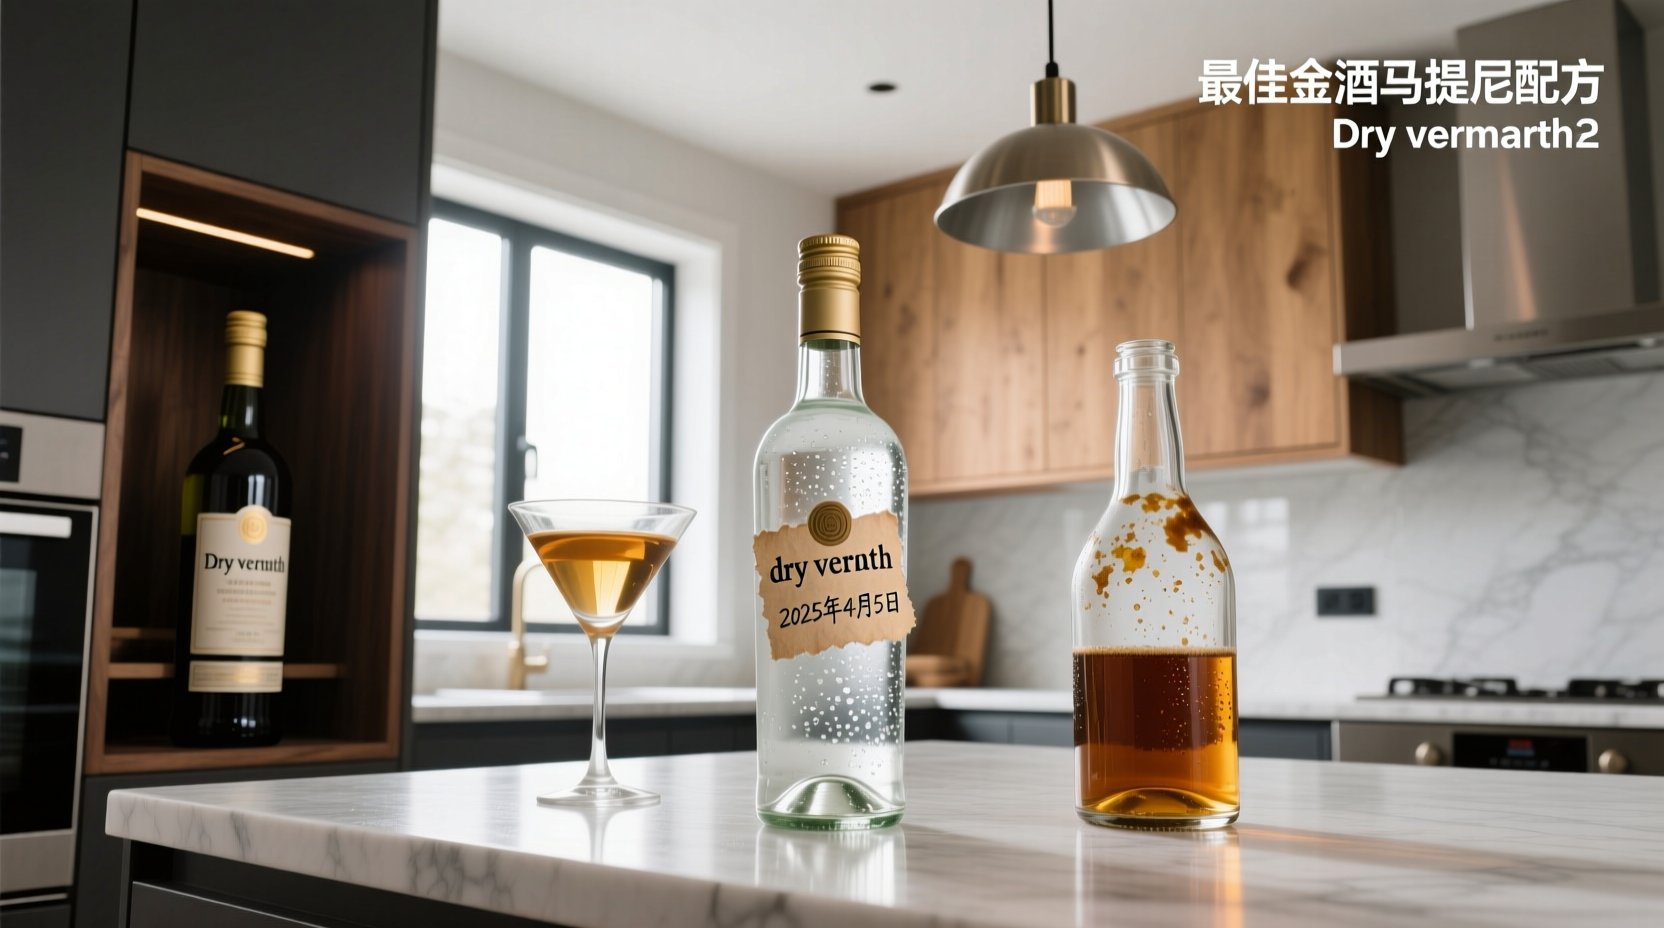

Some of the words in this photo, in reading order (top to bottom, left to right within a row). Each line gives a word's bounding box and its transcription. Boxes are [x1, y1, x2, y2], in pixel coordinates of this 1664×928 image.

[204, 553, 234, 576] Dry
[769, 556, 809, 588] dry
[779, 591, 899, 629] 2025年4月5日
